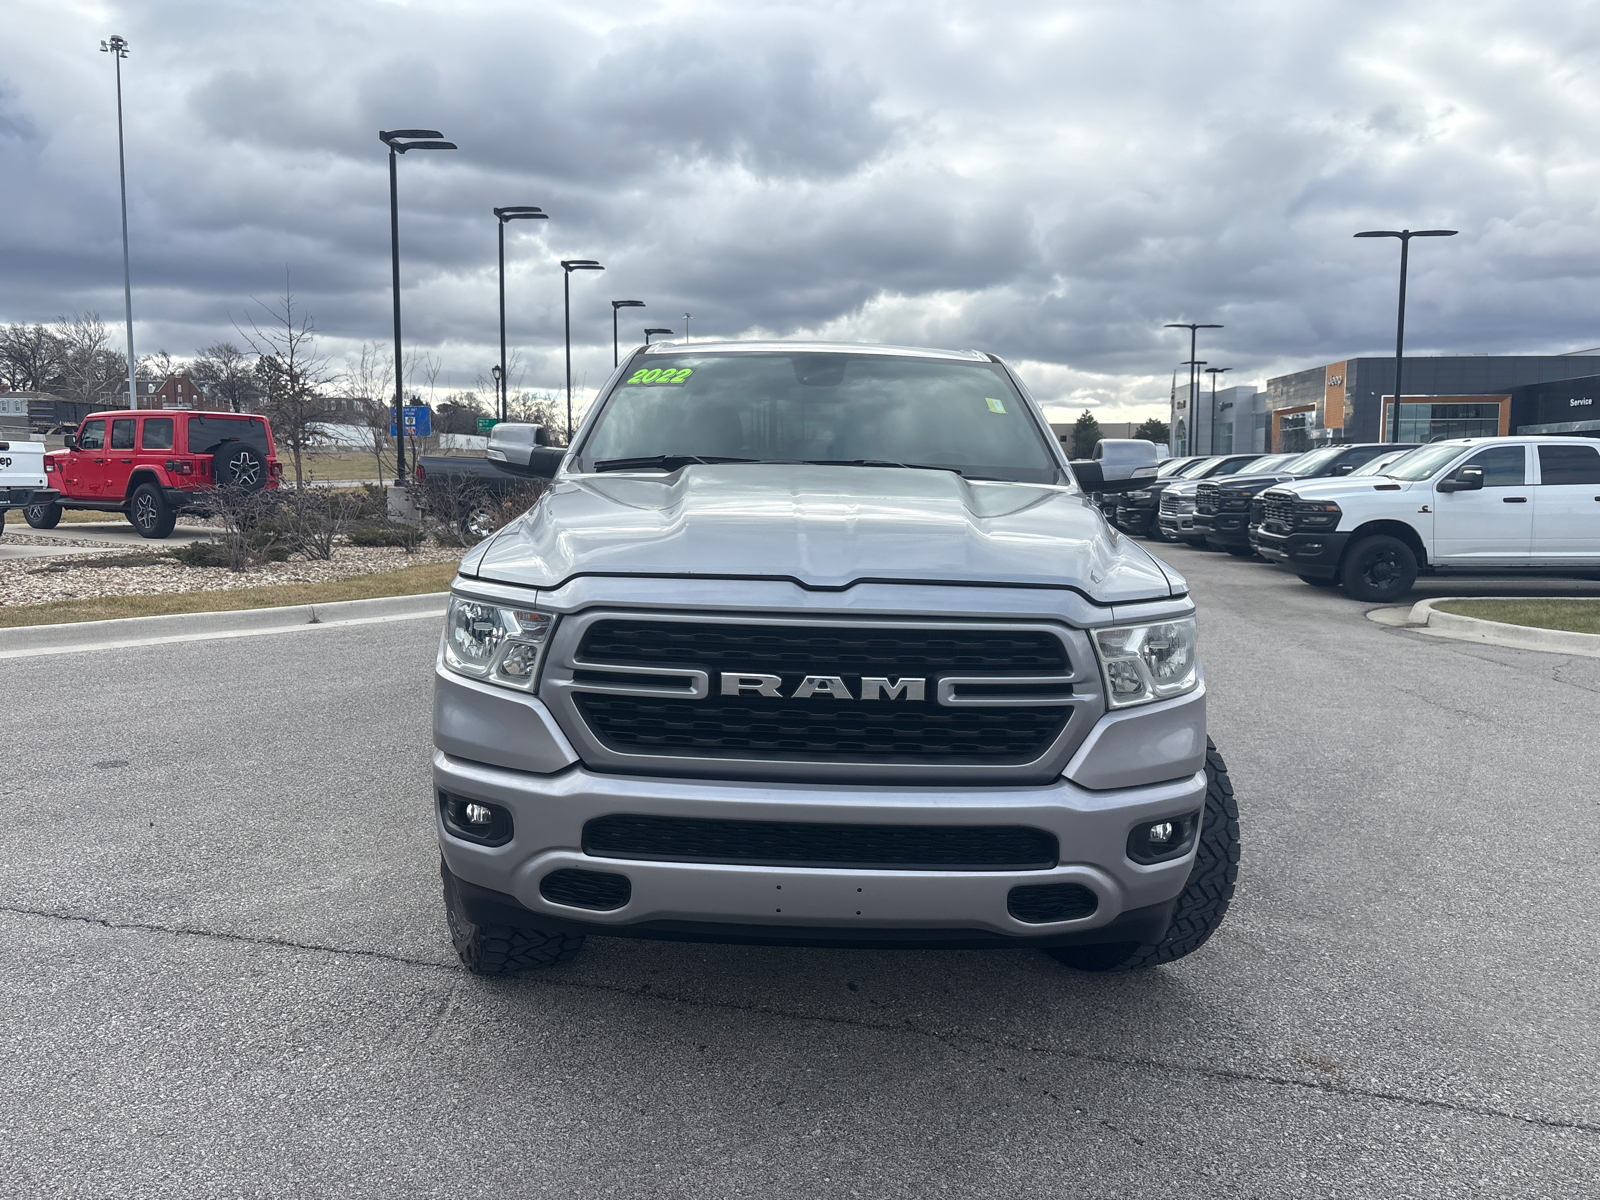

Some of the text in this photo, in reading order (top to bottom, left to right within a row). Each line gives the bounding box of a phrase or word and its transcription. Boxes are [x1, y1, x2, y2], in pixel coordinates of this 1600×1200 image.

[627, 368, 693, 384] 2022
[1327, 375, 1343, 386] Jeep
[1569, 397, 1593, 407] Service
[720, 672, 926, 701] RAM
